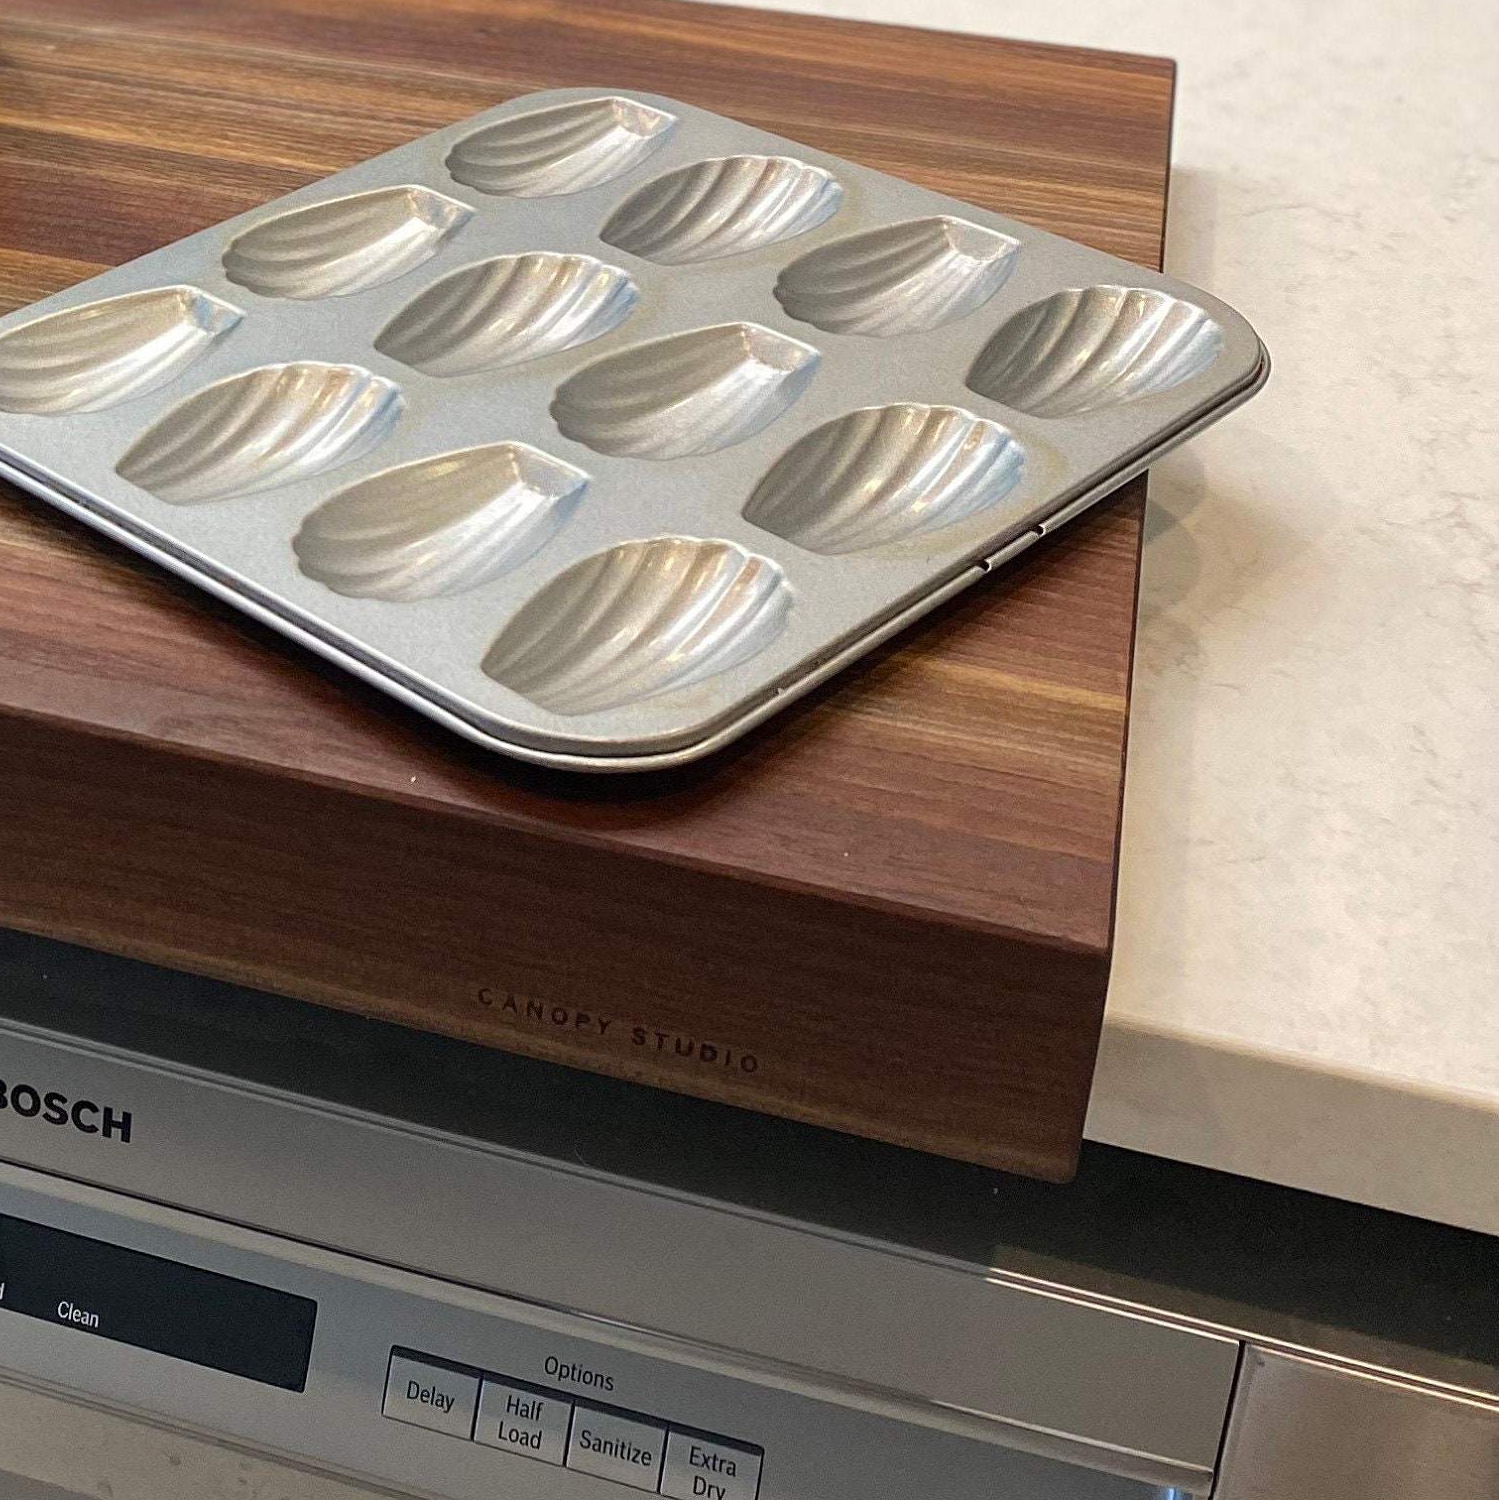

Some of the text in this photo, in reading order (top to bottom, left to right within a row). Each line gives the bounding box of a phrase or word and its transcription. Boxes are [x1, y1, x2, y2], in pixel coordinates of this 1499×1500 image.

[478, 988, 758, 1073] CANOPY STUDIO
[57, 1301, 100, 1328] Clean
[544, 1356, 614, 1392] Options
[406, 1380, 455, 1414] Delay
[506, 1395, 543, 1422] Half
[498, 1421, 542, 1450] Load
[579, 1430, 652, 1467] Sanitize
[689, 1446, 736, 1477] Extra
[693, 1475, 726, 1500] Dry
